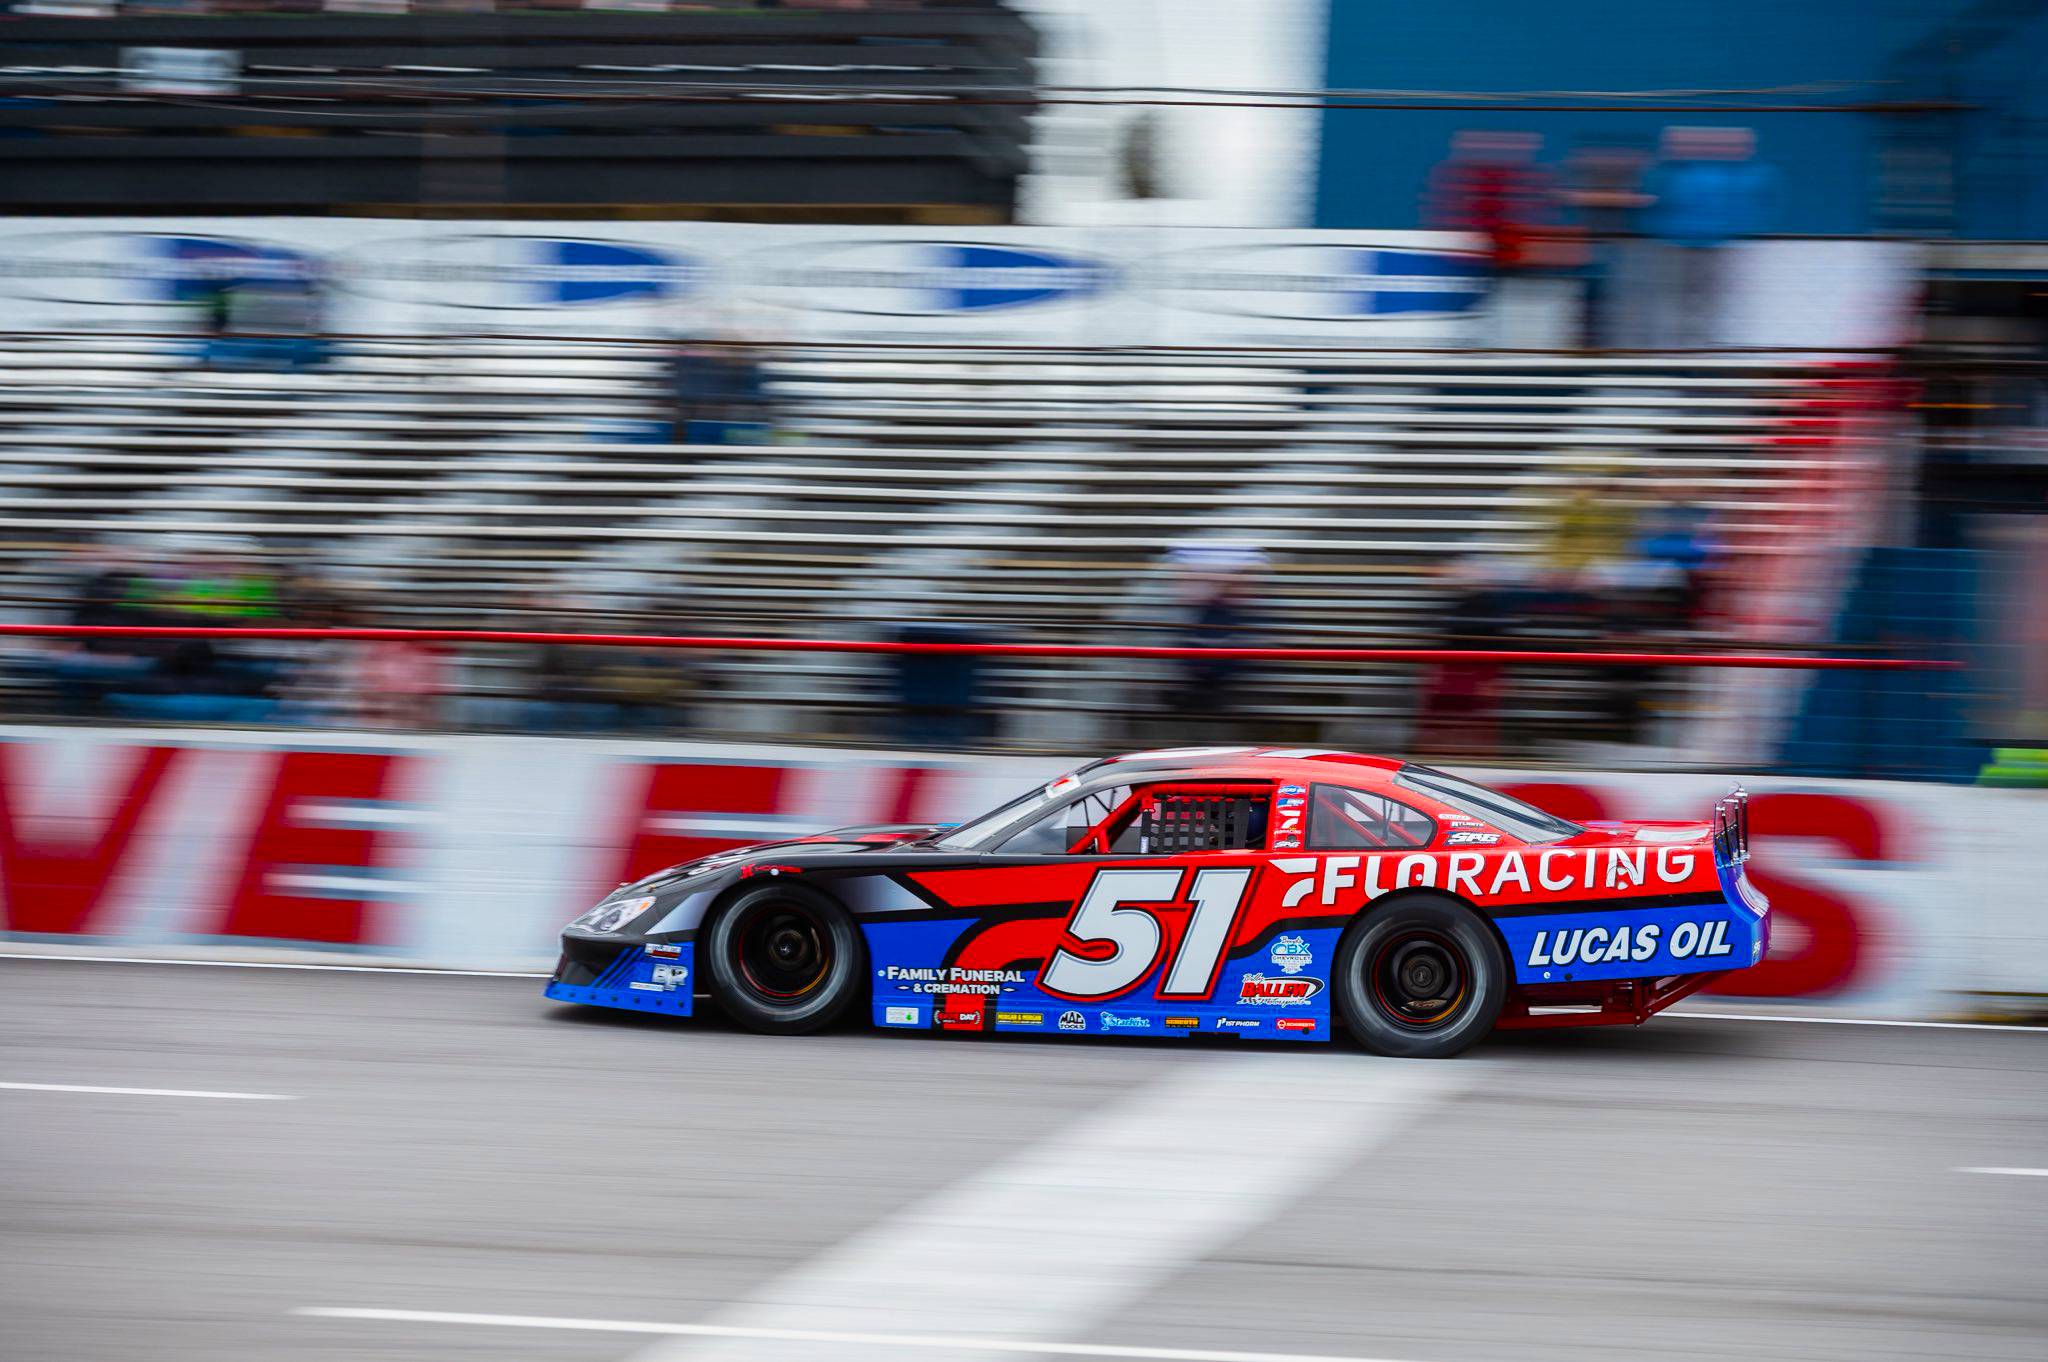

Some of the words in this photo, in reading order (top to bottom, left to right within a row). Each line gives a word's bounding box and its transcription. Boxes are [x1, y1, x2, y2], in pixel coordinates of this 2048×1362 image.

[1042, 868, 1251, 995] 51
[1528, 924, 1661, 967] LUCAS
[1668, 920, 1735, 957] OIL
[887, 966, 947, 981] FAMILY
[950, 967, 1025, 983] FUNERAL
[913, 983, 923, 993] &
[923, 983, 1000, 995] CREMATION
[1060, 1012, 1085, 1024] MAC
